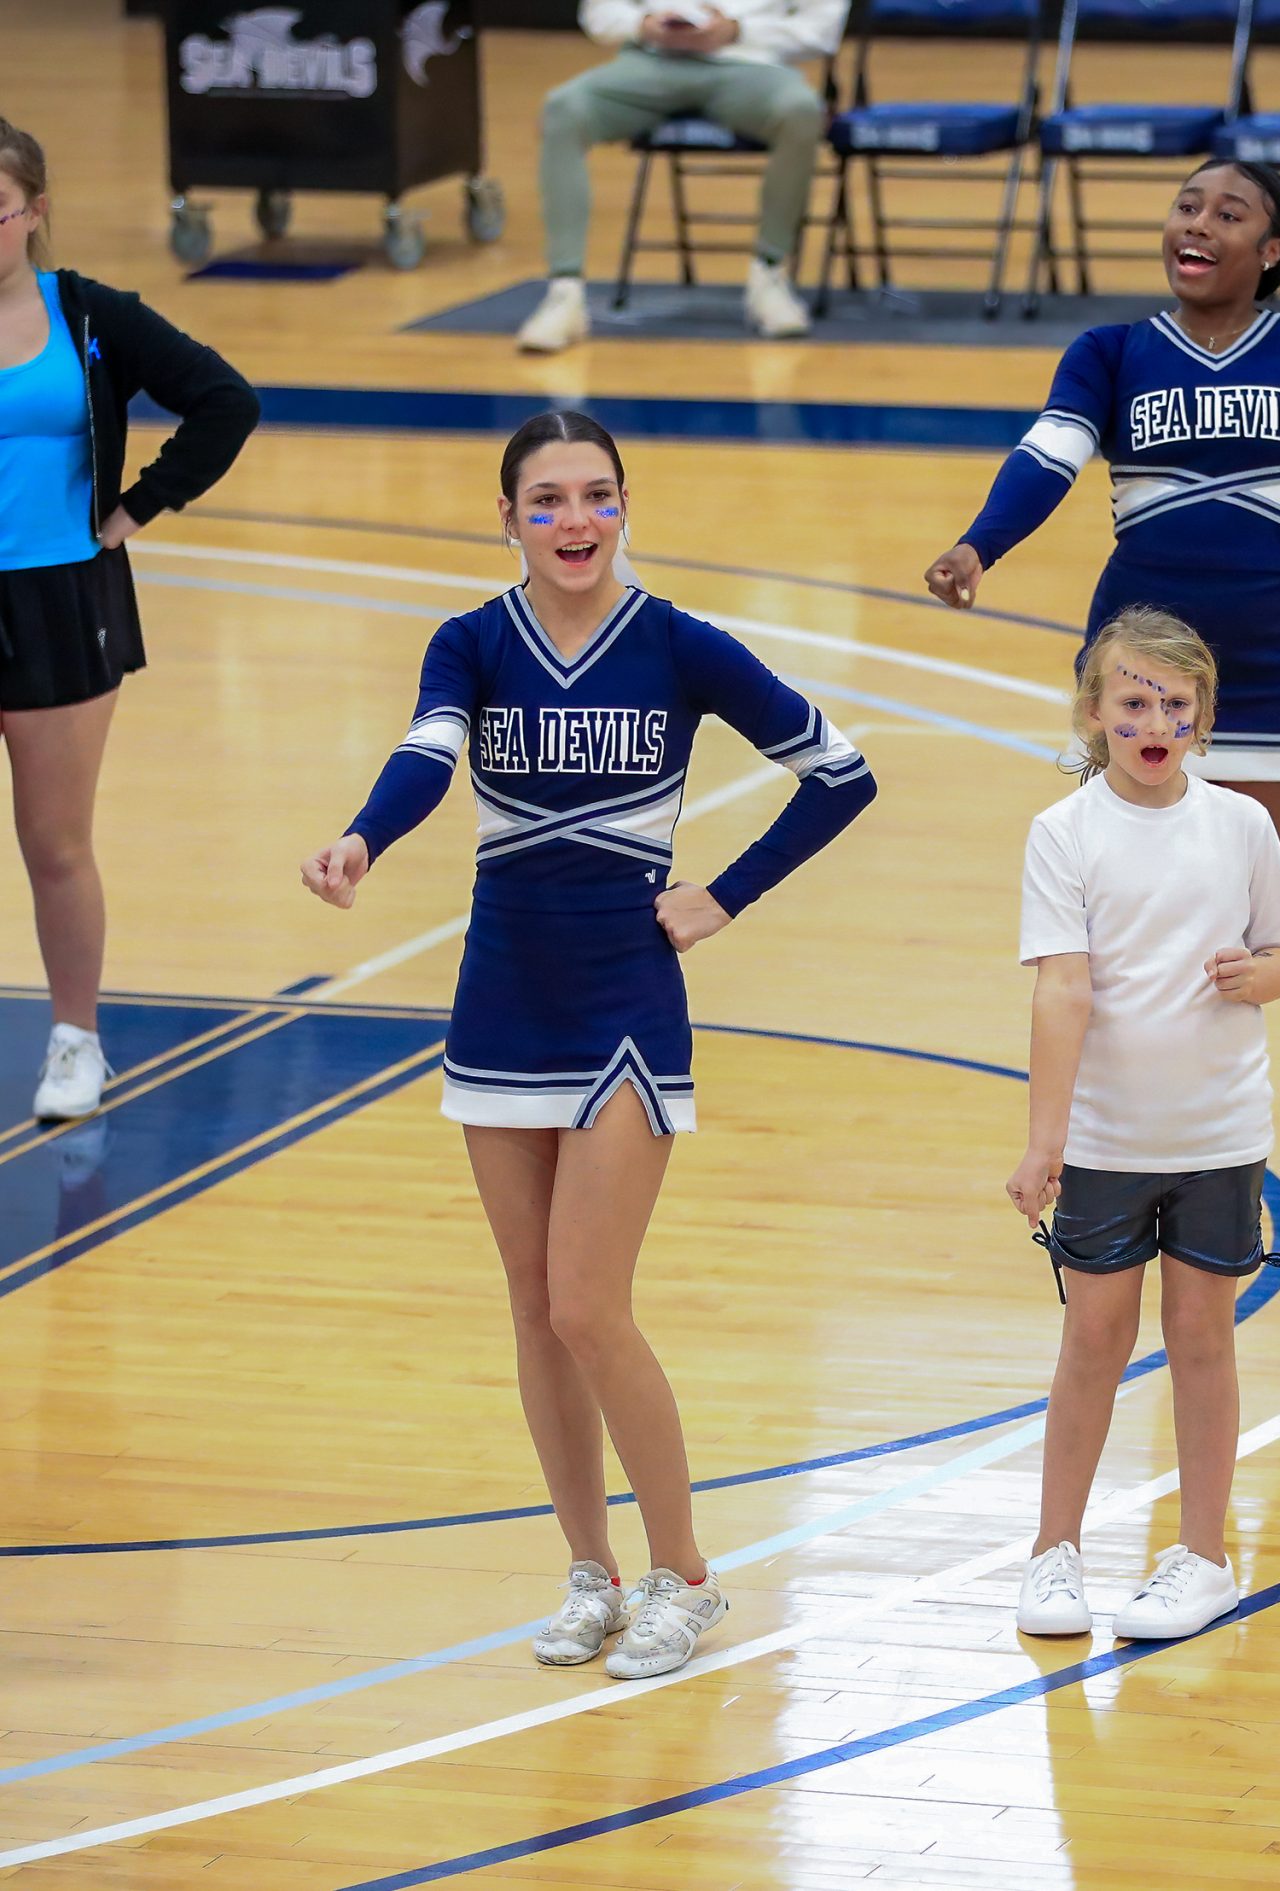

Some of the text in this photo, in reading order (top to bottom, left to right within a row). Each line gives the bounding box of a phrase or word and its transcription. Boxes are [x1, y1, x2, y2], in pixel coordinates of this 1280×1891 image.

[1130, 387, 1191, 452] SEA
[479, 707, 668, 775] SEA DEVILS
